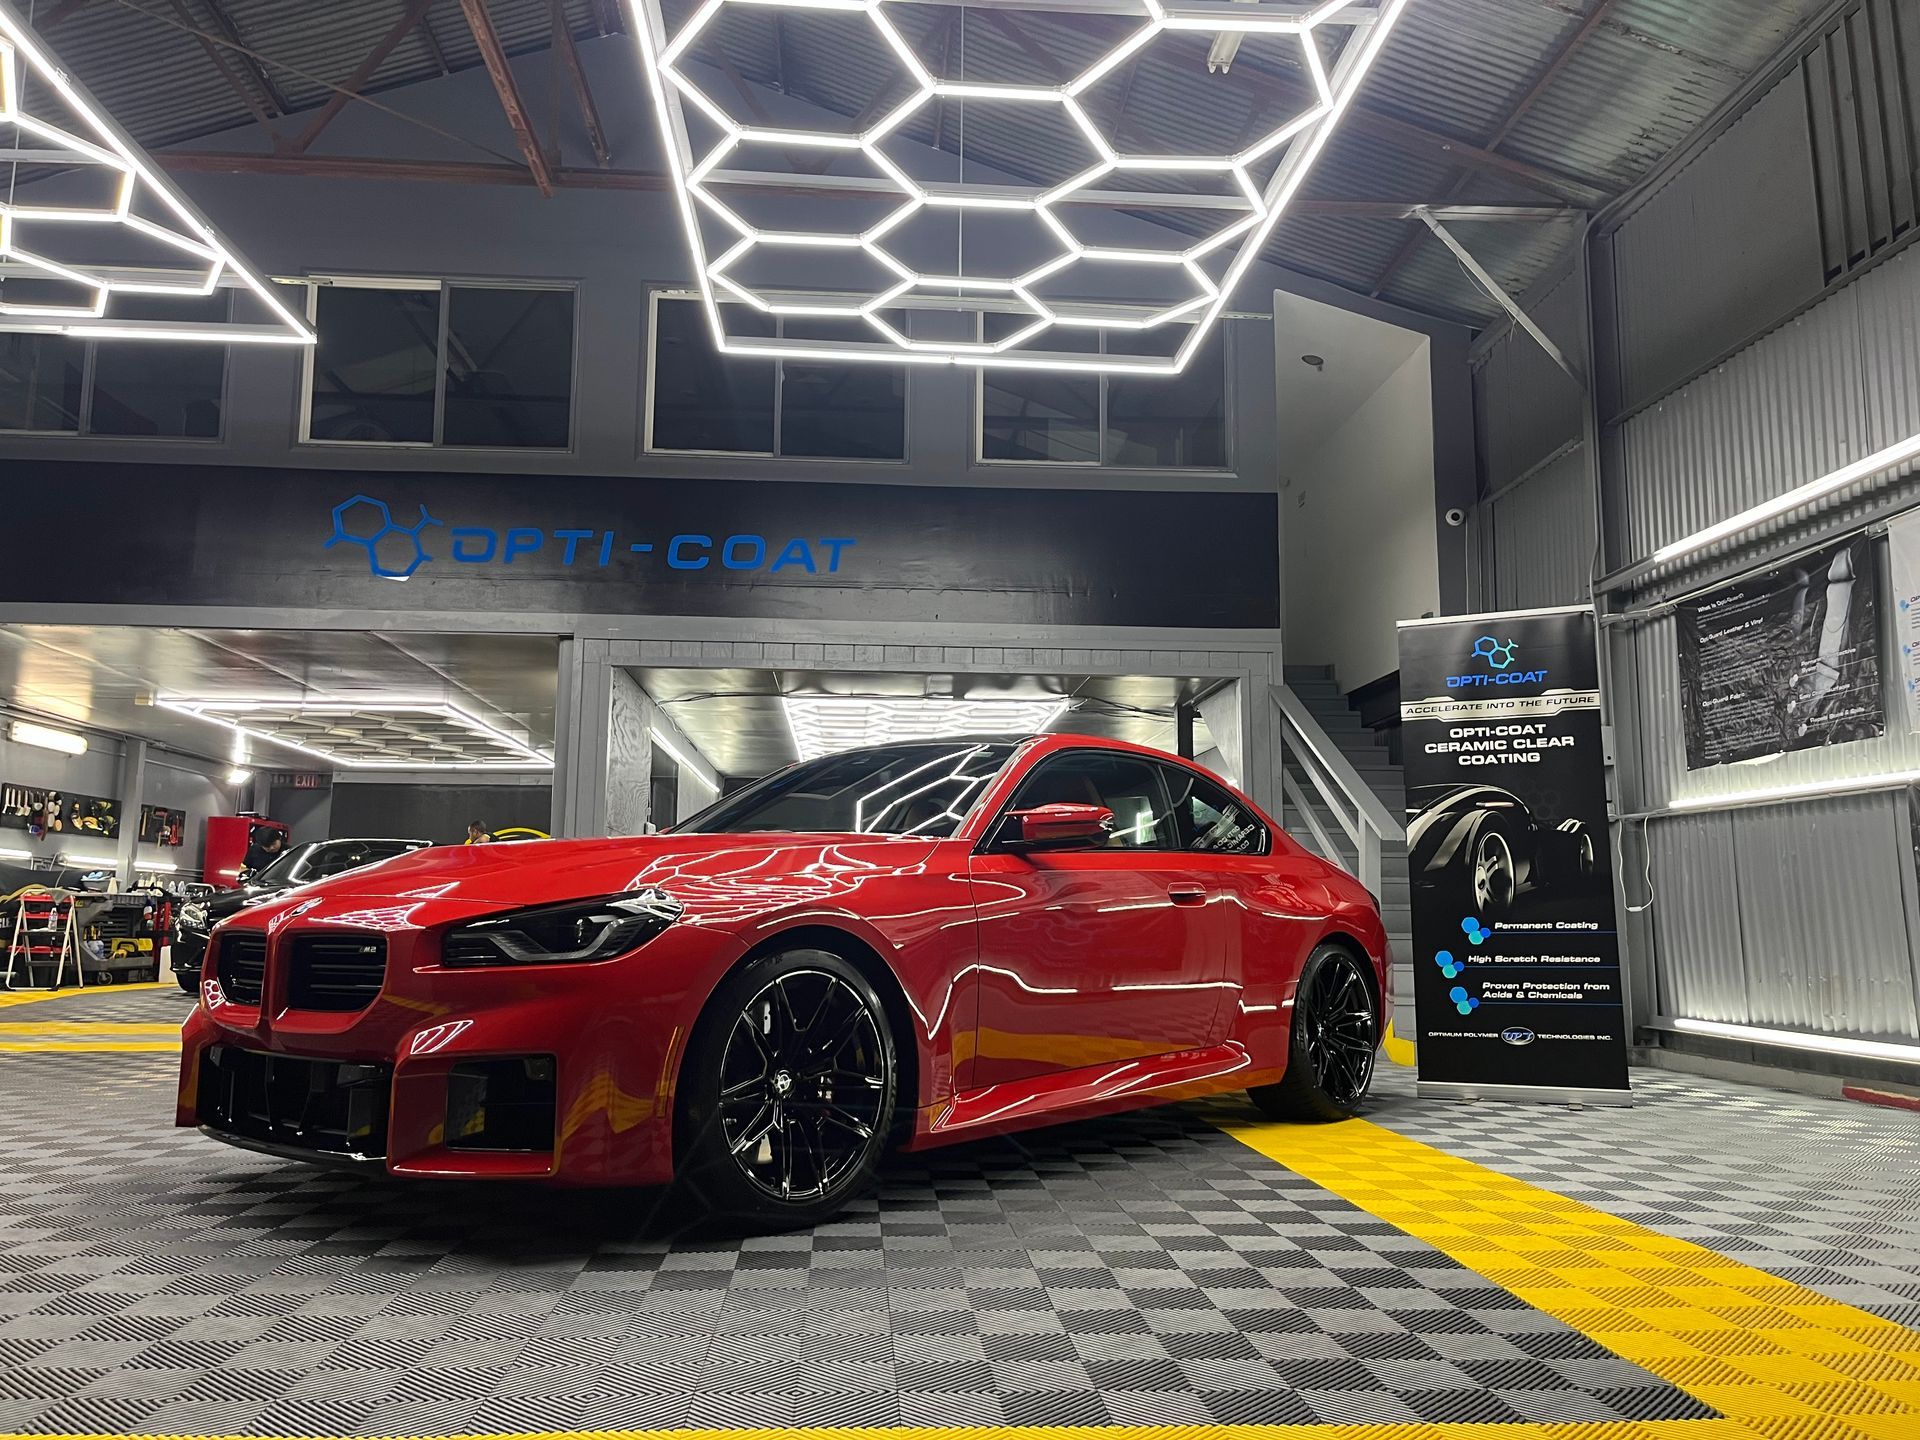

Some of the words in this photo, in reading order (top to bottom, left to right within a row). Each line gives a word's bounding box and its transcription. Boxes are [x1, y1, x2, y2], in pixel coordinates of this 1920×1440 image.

[1446, 670, 1548, 688] OPTI-COAT
[1406, 703, 1483, 715] ACCELERATE
[1487, 701, 1515, 710] INTO
[1520, 699, 1542, 708] THE
[1546, 696, 1595, 706] FUTURE
[1449, 723, 1547, 739] OPTI-COAT
[1424, 739, 1508, 754] CERAMIC
[1513, 736, 1575, 750] CLEAR
[1458, 752, 1541, 766] COATING
[1494, 921, 1553, 930] Permanent
[1555, 921, 1599, 931] Coating
[1467, 955, 1492, 964] High
[1494, 955, 1538, 963] Scratch
[1540, 955, 1601, 963] Resistance
[1482, 982, 1520, 990] Proven
[1522, 982, 1580, 990] Protection
[1583, 982, 1610, 990] from
[1482, 991, 1513, 999] Acids
[1515, 991, 1525, 999] &
[1527, 991, 1583, 999] Chemicals
